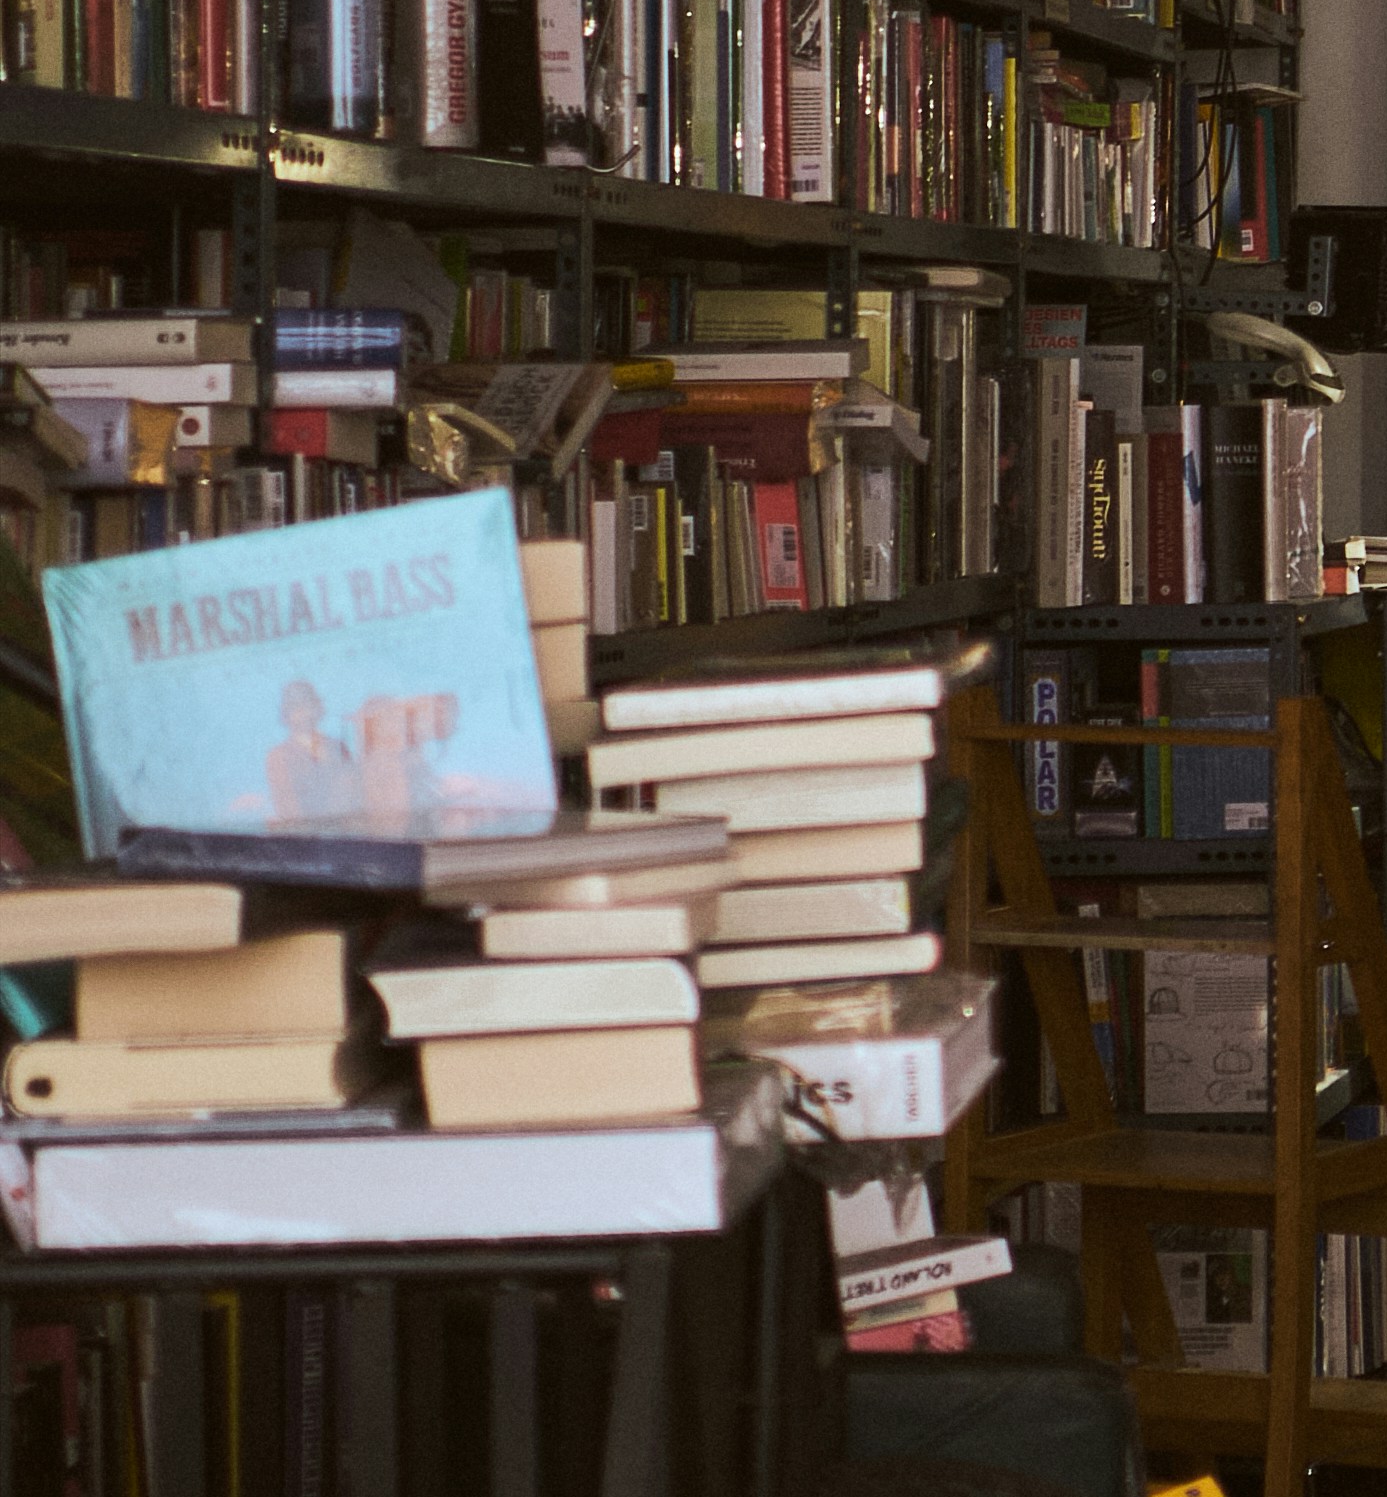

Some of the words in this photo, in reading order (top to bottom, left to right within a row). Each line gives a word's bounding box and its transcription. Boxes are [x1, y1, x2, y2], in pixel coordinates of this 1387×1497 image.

[448, 37, 467, 125] GREGOR
[123, 573, 347, 665] MARSHAL
[345, 553, 457, 624] BASS
